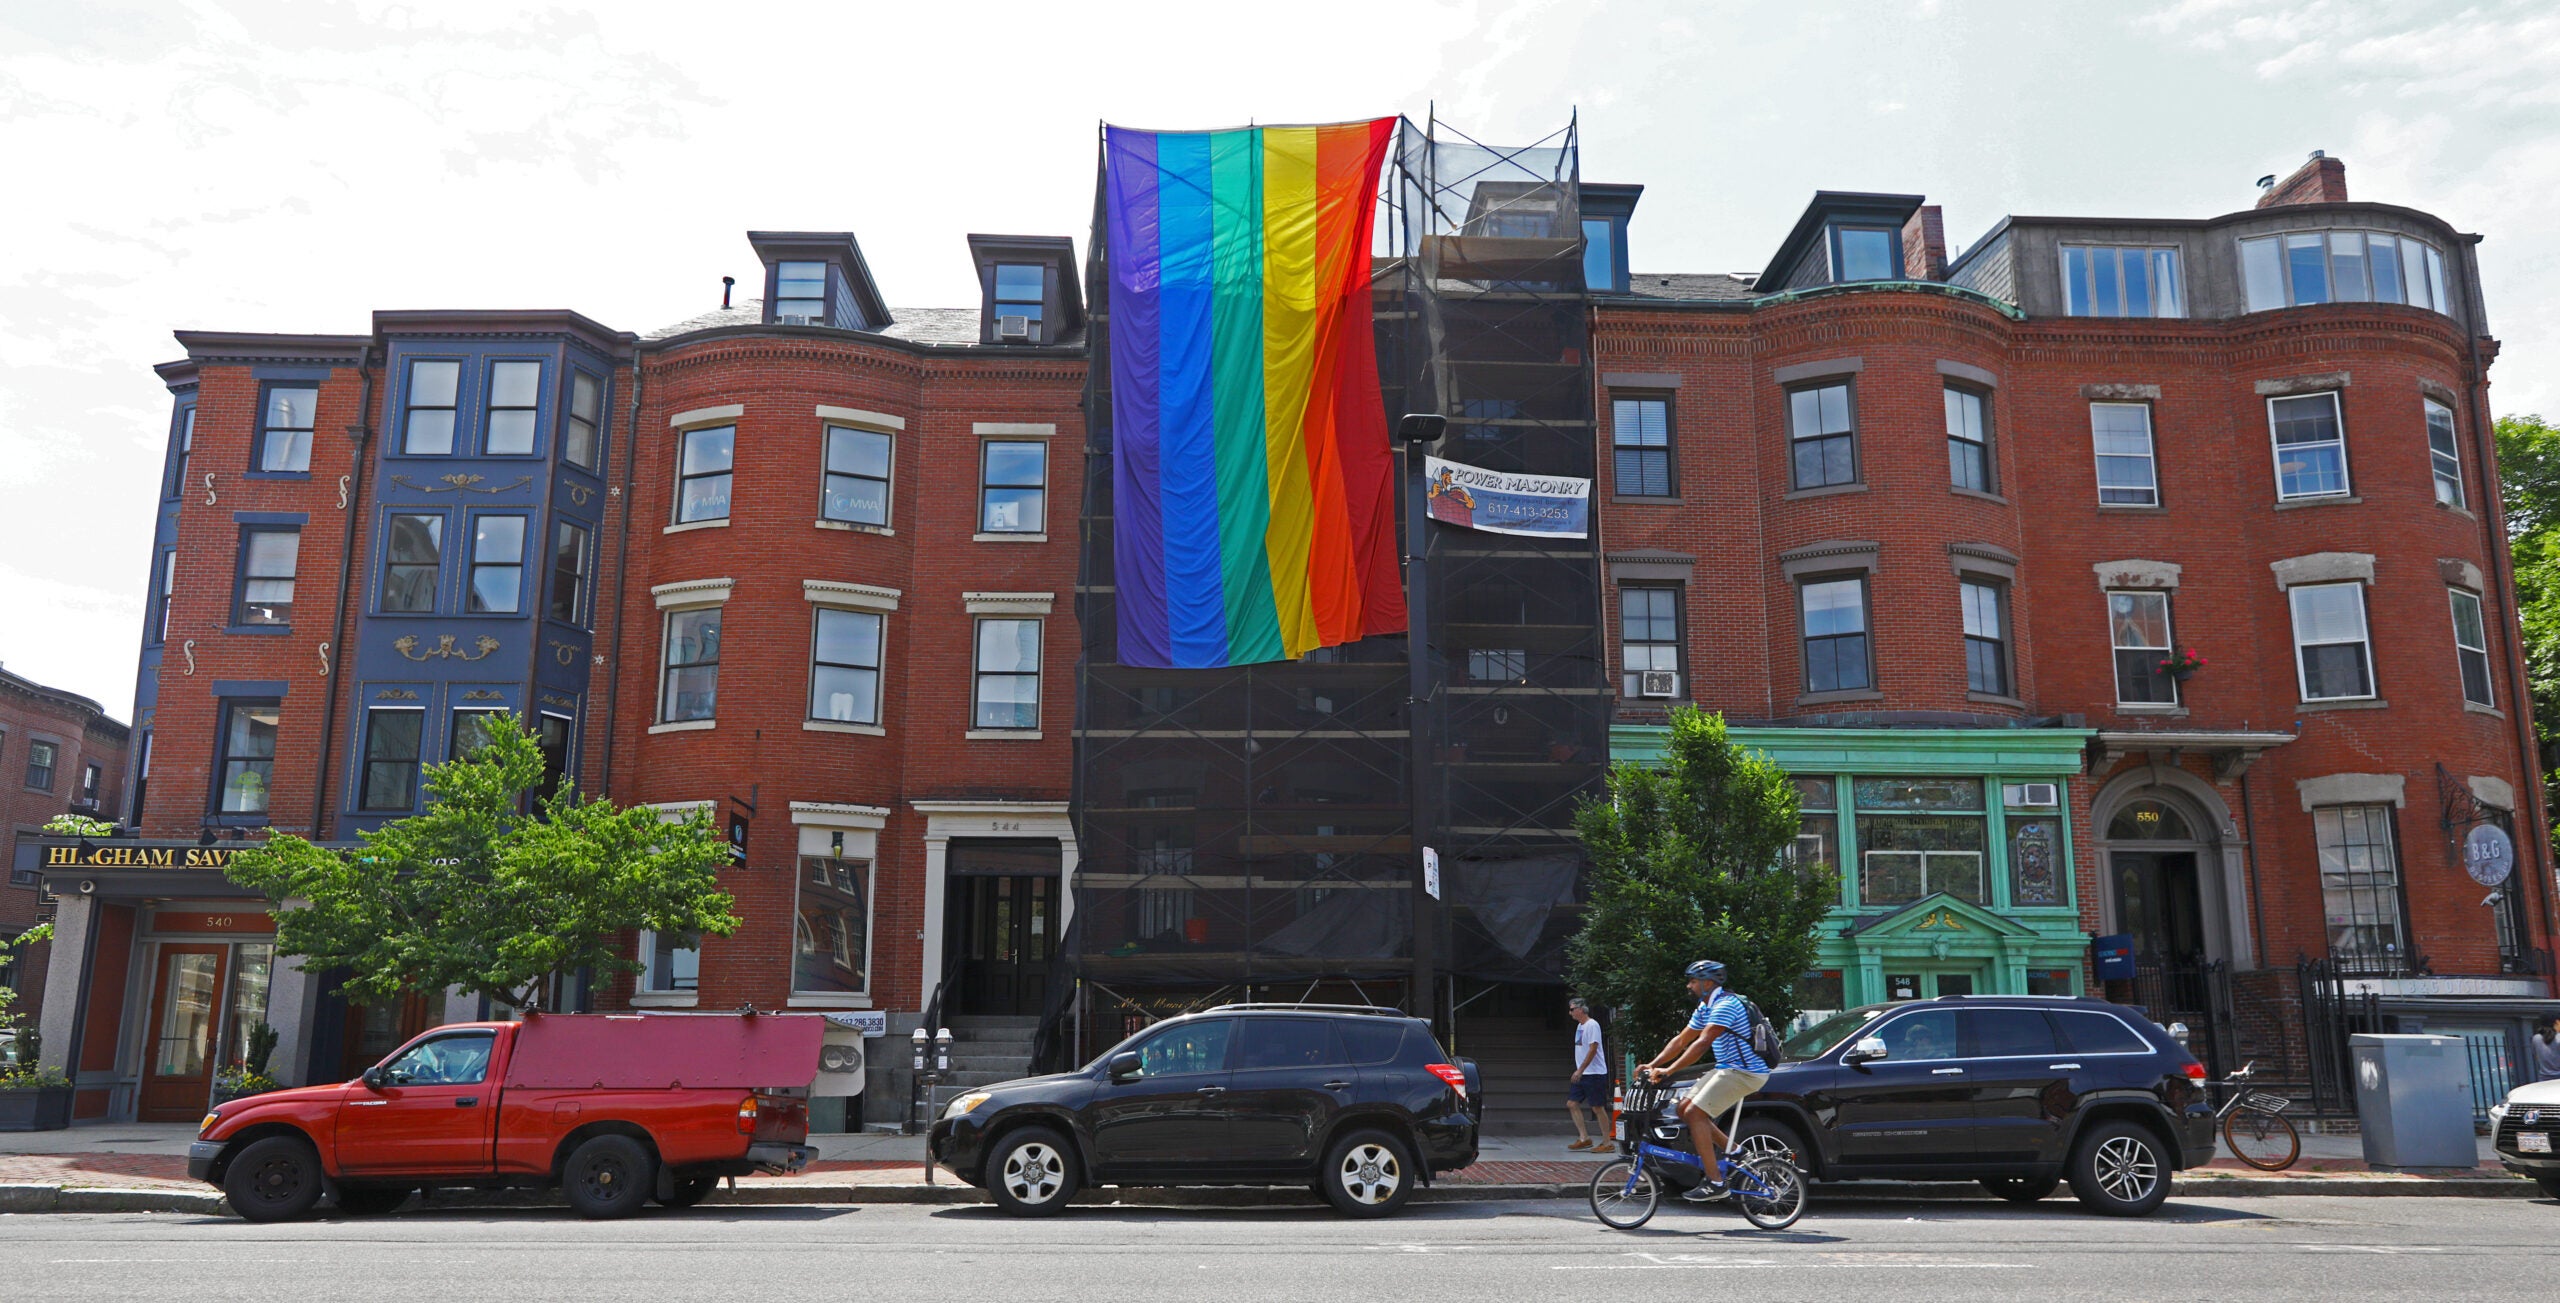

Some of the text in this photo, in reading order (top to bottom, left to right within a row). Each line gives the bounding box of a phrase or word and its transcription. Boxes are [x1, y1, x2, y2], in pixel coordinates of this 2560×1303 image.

[1454, 468, 1584, 495] POWER MASONRY
[849, 498, 879, 511] MWA
[1488, 502, 1569, 519] 617-413-3253
[2137, 812, 2159, 822] 550
[992, 822, 1020, 831] 544
[2472, 839, 2500, 860] B&G
[207, 917, 232, 927] 540
[1895, 977, 1911, 986] 548
[854, 1018, 867, 1027] 286
[868, 1017, 884, 1026] 3830
